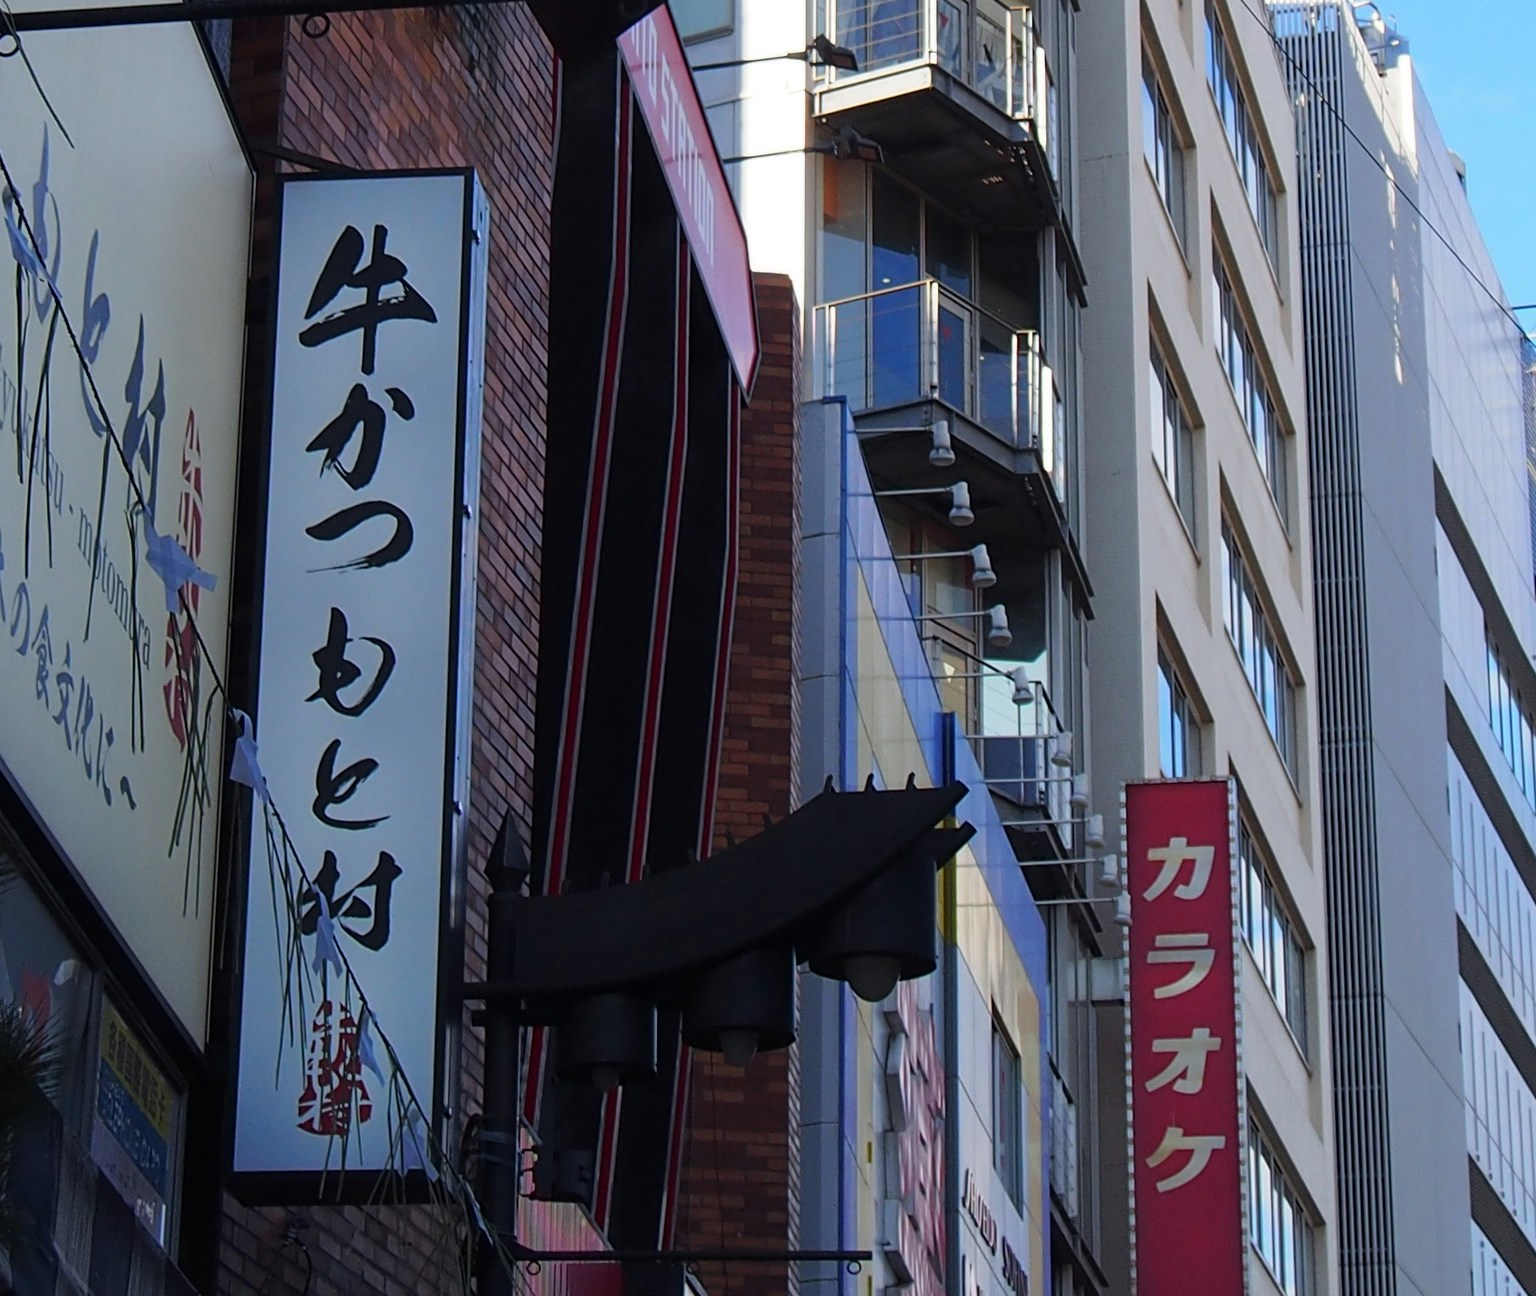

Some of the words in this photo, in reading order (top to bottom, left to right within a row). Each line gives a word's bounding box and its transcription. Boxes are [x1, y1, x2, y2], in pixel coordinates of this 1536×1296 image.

[298, 224, 438, 952] 牛かつもと村
[1140, 836, 1226, 1194] カラオケ
